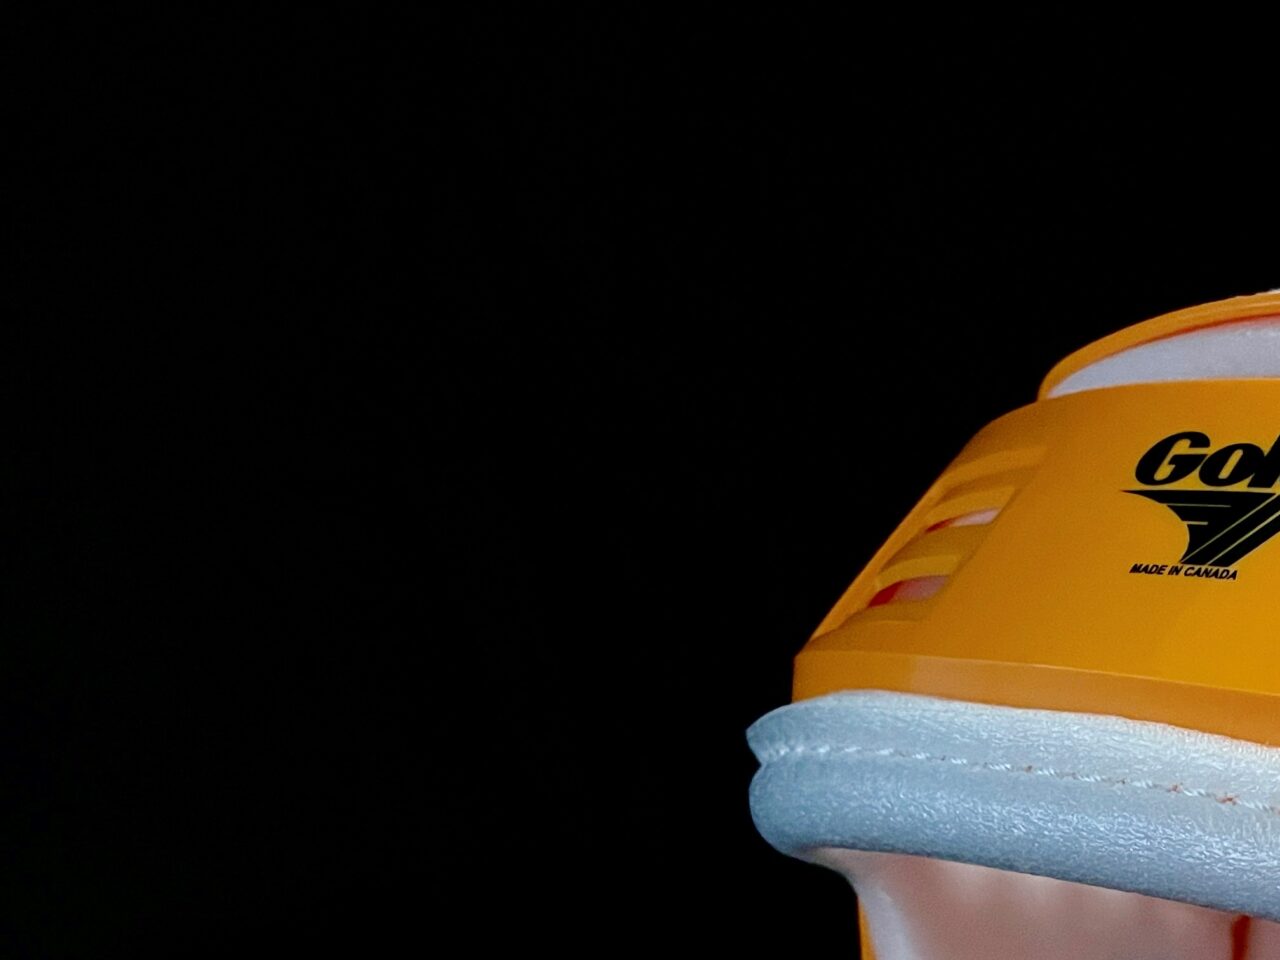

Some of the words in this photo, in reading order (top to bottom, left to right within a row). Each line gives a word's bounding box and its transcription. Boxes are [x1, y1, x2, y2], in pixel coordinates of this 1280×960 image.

[1129, 563, 1167, 576] MADE
[1168, 564, 1183, 577] IN
[1184, 566, 1239, 581] CANADA
